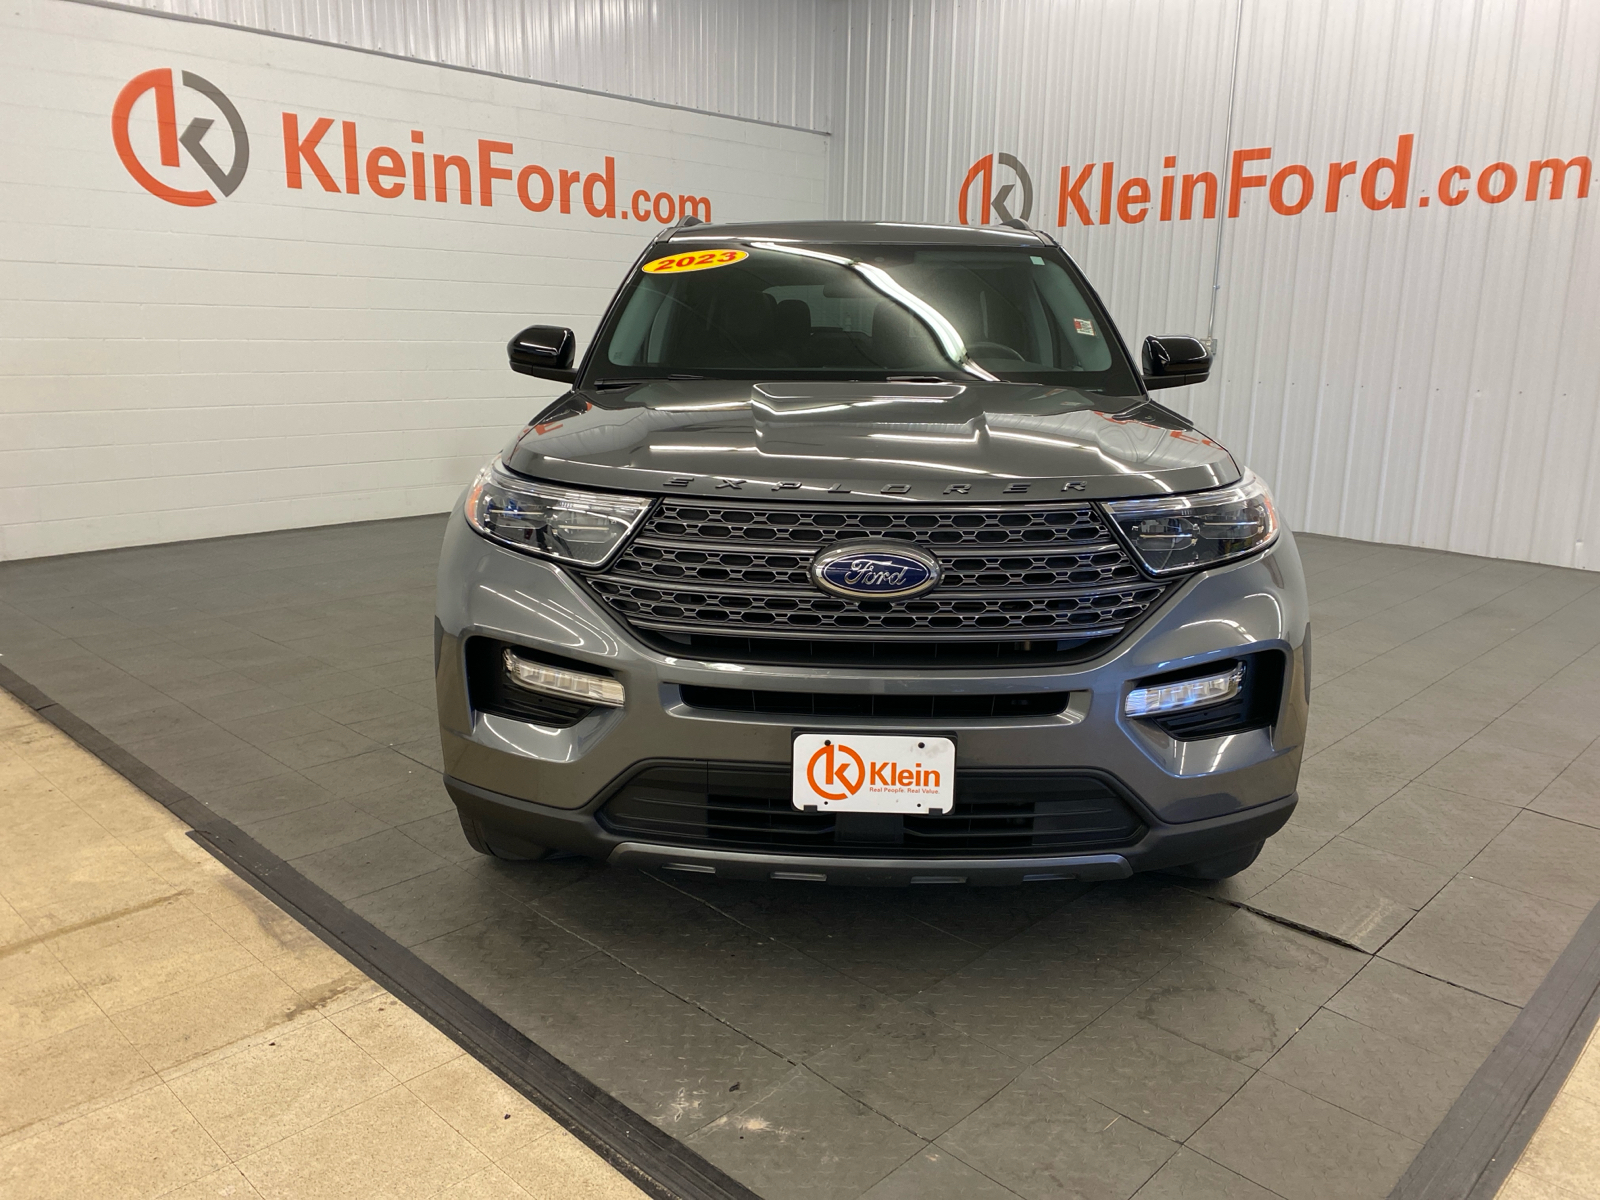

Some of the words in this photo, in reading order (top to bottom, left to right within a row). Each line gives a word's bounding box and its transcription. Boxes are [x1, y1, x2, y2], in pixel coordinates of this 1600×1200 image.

[282, 112, 712, 224] KleinFord.com
[1057, 133, 1592, 228] KleinFord.com
[653, 251, 737, 271] 2023
[662, 476, 1089, 495] EXPLORER
[843, 558, 908, 587] Ford
[869, 761, 941, 788] Klein
